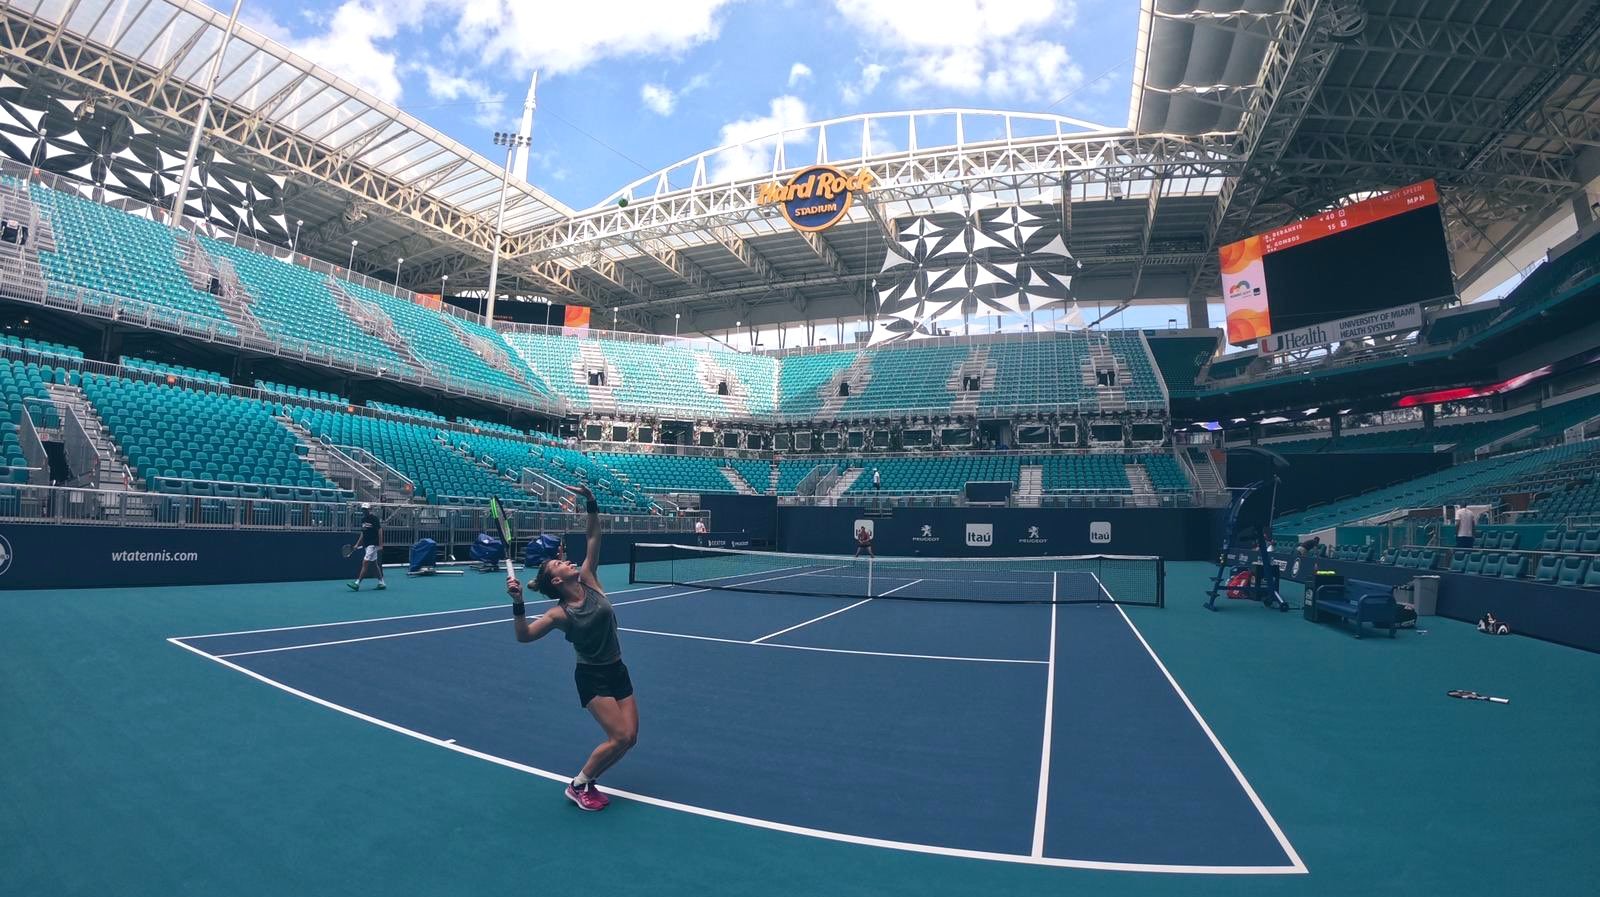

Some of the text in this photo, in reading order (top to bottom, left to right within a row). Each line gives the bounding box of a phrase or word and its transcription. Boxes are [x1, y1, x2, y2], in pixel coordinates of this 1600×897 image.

[756, 168, 874, 205] Hard Rock
[1407, 194, 1425, 205] MPH
[795, 203, 837, 217] STADIUM
[1327, 223, 1336, 231] 15
[1339, 307, 1416, 330] UNIVERSITY OF MIAMI
[1339, 320, 1396, 339] HEALTH SYSTEM
[967, 531, 991, 543] Itaú
[1091, 531, 1110, 540] Itaú
[111, 549, 198, 562] wtatennis.com
